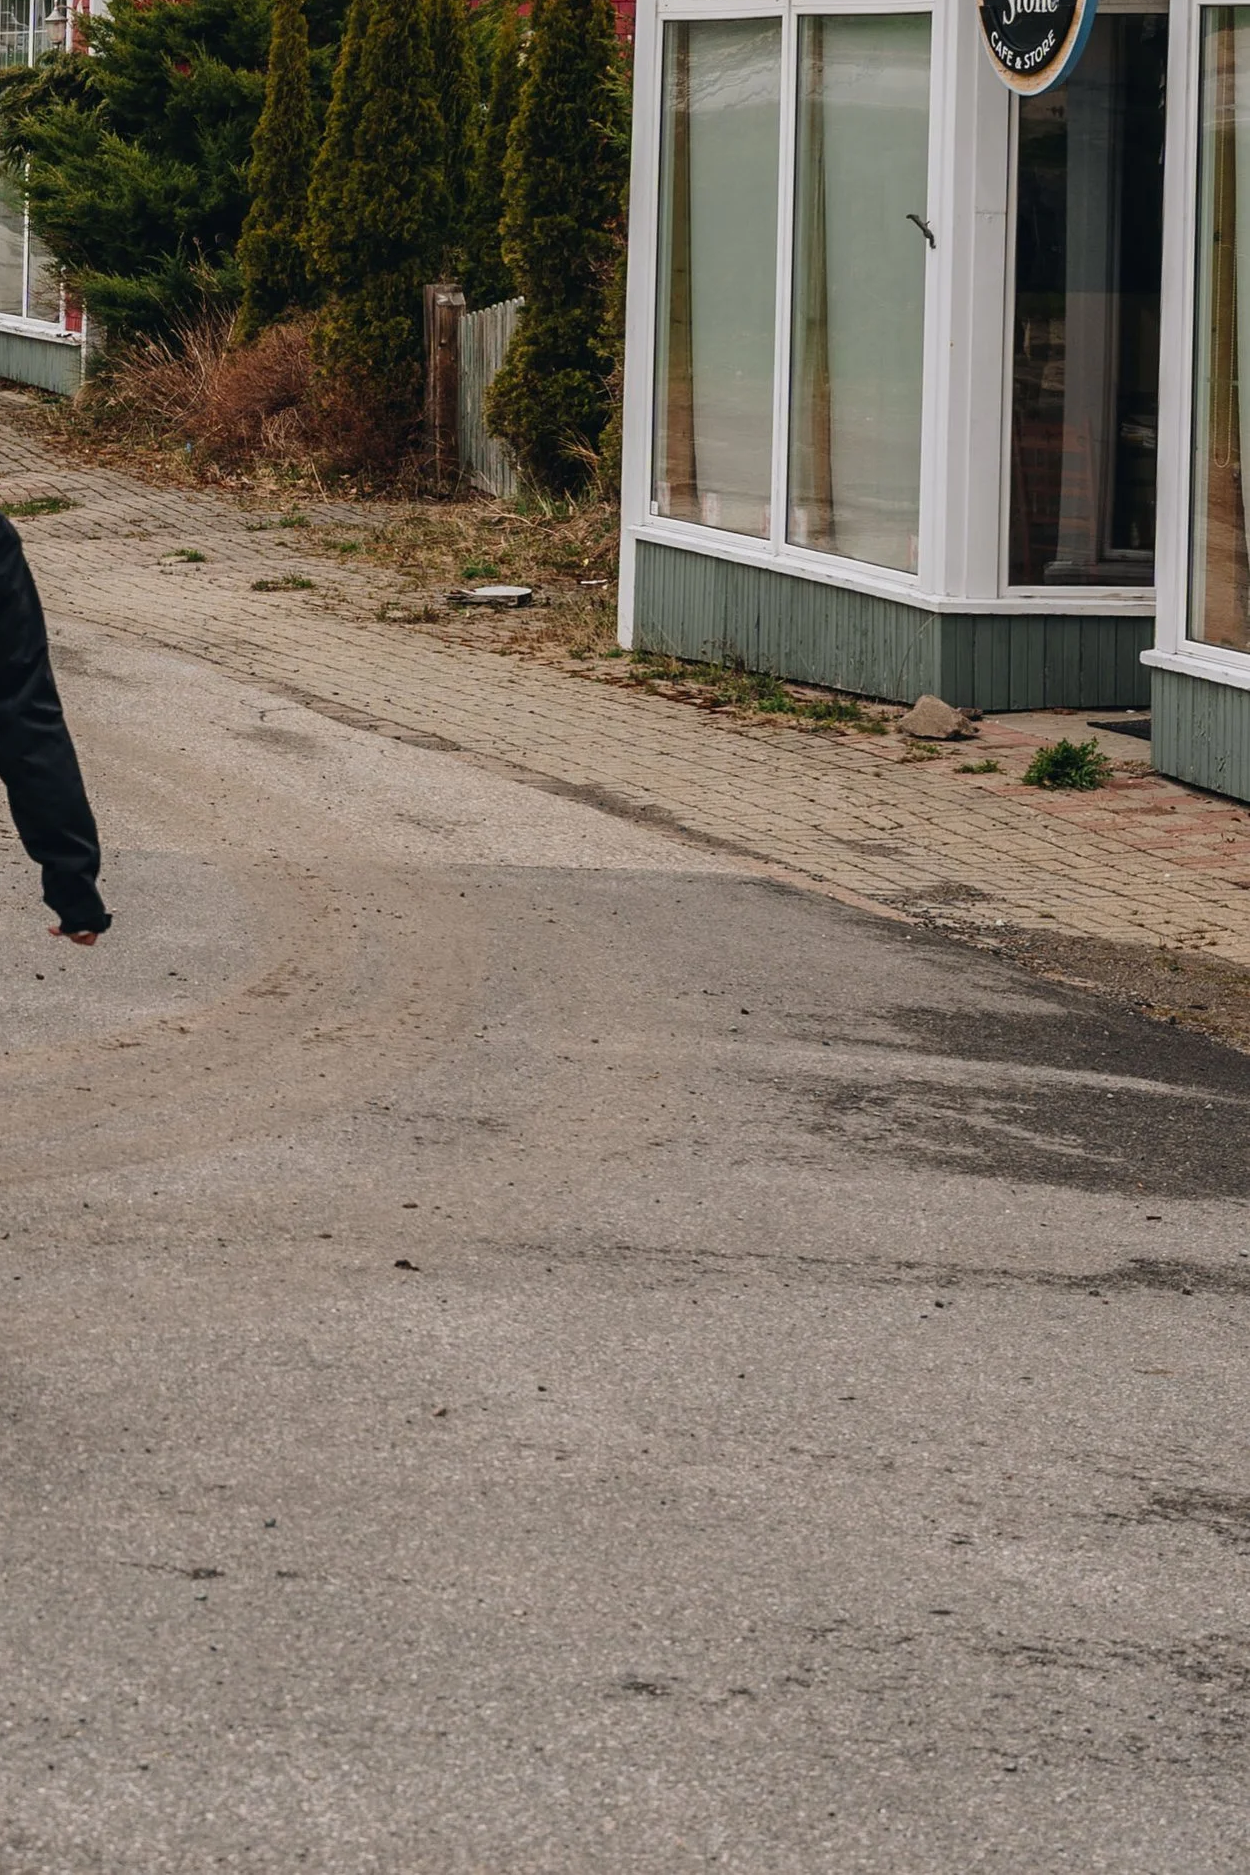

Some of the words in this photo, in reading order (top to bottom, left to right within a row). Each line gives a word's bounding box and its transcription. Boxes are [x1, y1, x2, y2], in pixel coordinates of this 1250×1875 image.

[990, 31, 1013, 67] CAFE
[1014, 57, 1023, 70] &
[1024, 29, 1056, 69] STORE
